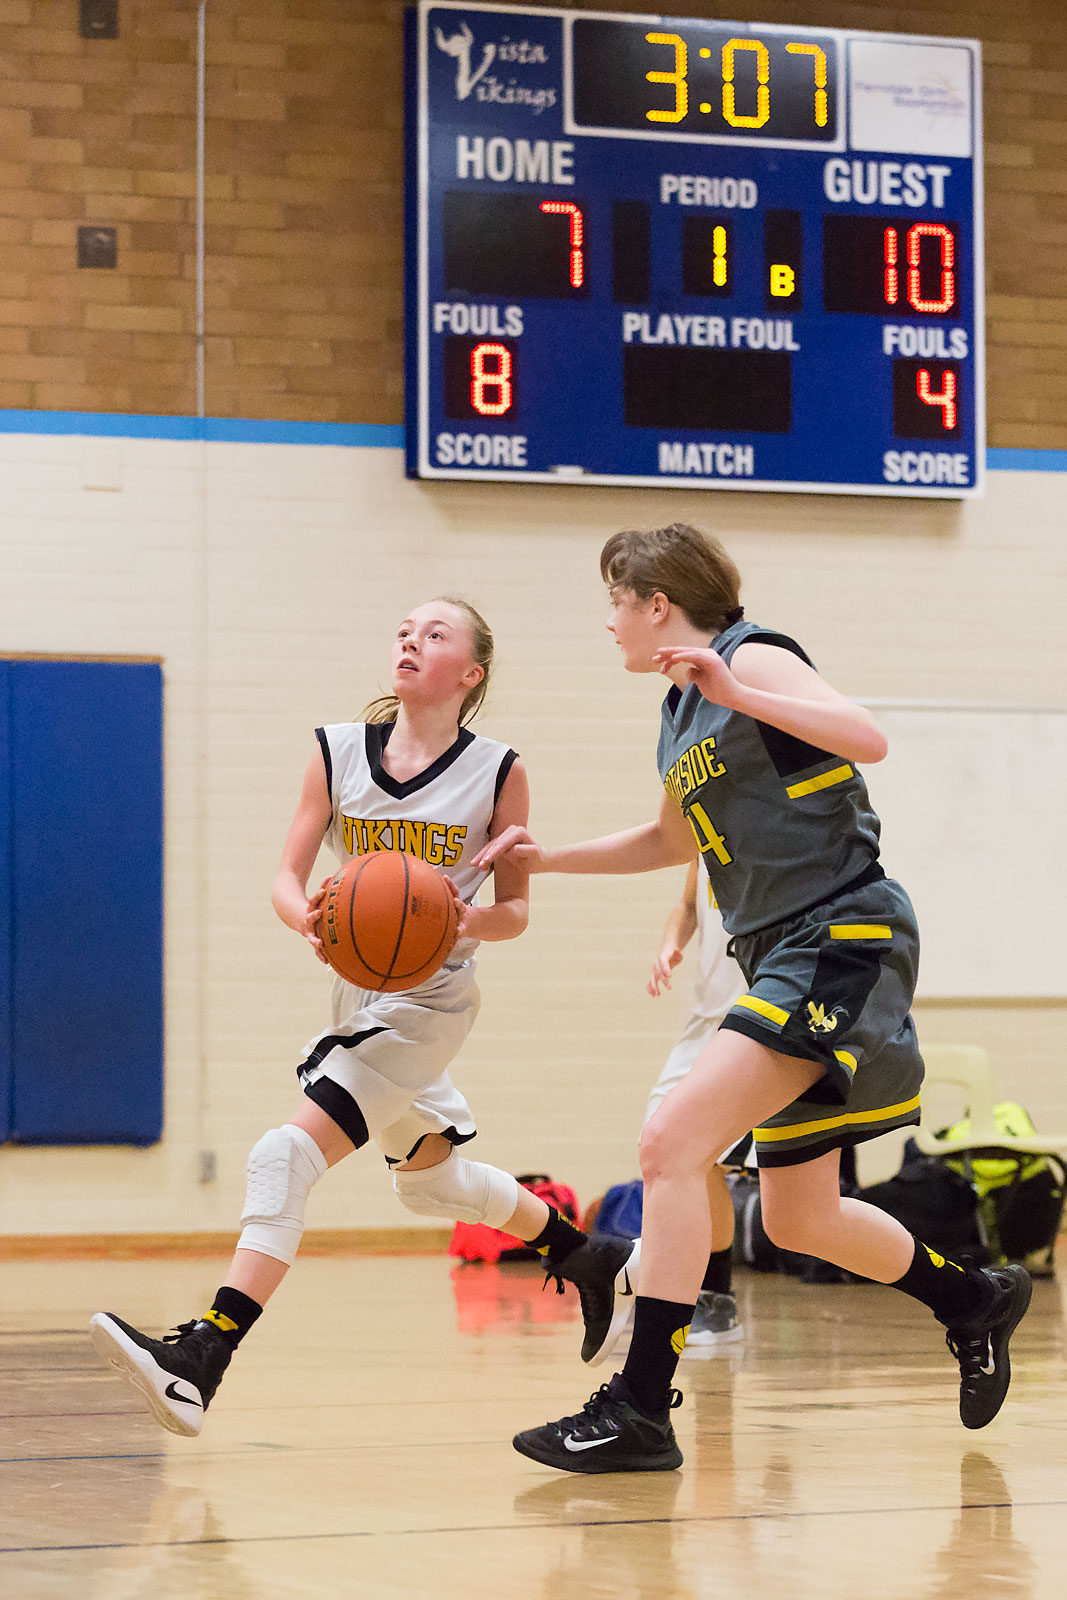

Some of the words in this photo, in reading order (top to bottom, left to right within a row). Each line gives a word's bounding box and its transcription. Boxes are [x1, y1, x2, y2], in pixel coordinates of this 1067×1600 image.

[645, 32, 828, 129] 3:07
[457, 135, 576, 185] HOME
[824, 158, 952, 209] GUEST
[660, 174, 758, 209] PERIOD
[539, 200, 584, 288] 7
[712, 225, 727, 286] 1
[883, 222, 955, 314] 10
[769, 264, 795, 297] B
[433, 302, 524, 338] FOULS
[622, 312, 727, 348] PLAYER
[731, 317, 801, 351] FOUL
[883, 324, 969, 360] FOULS
[470, 342, 513, 417] 8
[915, 368, 957, 430] 4
[436, 432, 528, 468] SCORE
[658, 442, 755, 476] MATCH
[882, 451, 970, 485] SCORE
[341, 815, 468, 867] VIKINGS
